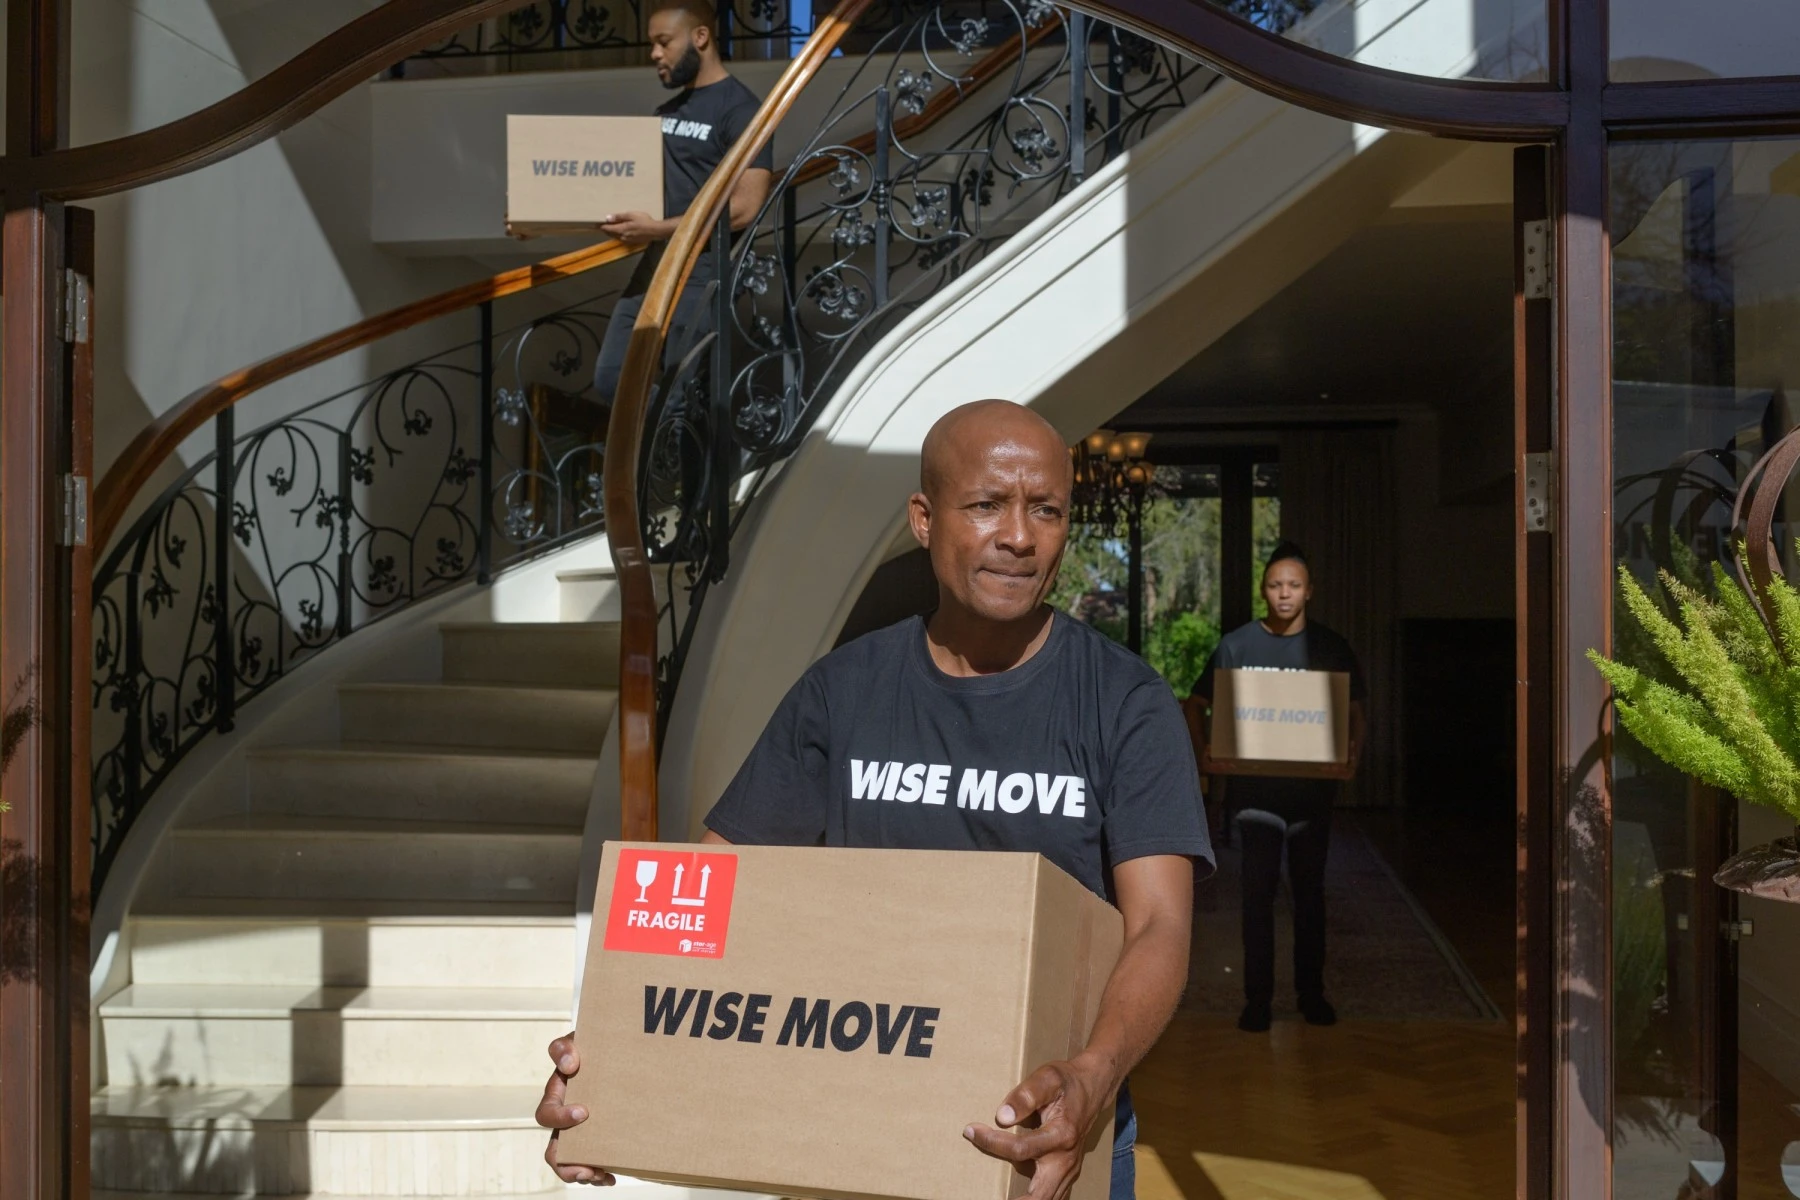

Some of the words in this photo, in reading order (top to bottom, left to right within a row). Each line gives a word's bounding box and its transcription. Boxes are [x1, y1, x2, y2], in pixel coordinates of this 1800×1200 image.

[674, 120, 712, 141] MOVE
[532, 159, 579, 176] WISE
[582, 160, 636, 177] MOVE
[1235, 707, 1276, 722] WISE
[1279, 708, 1328, 725] MOVE
[851, 759, 951, 805] WISE
[956, 768, 1086, 818] MOVE
[627, 909, 706, 932] FRAGILE
[644, 985, 772, 1043] WISE
[776, 997, 940, 1058] MOVE
